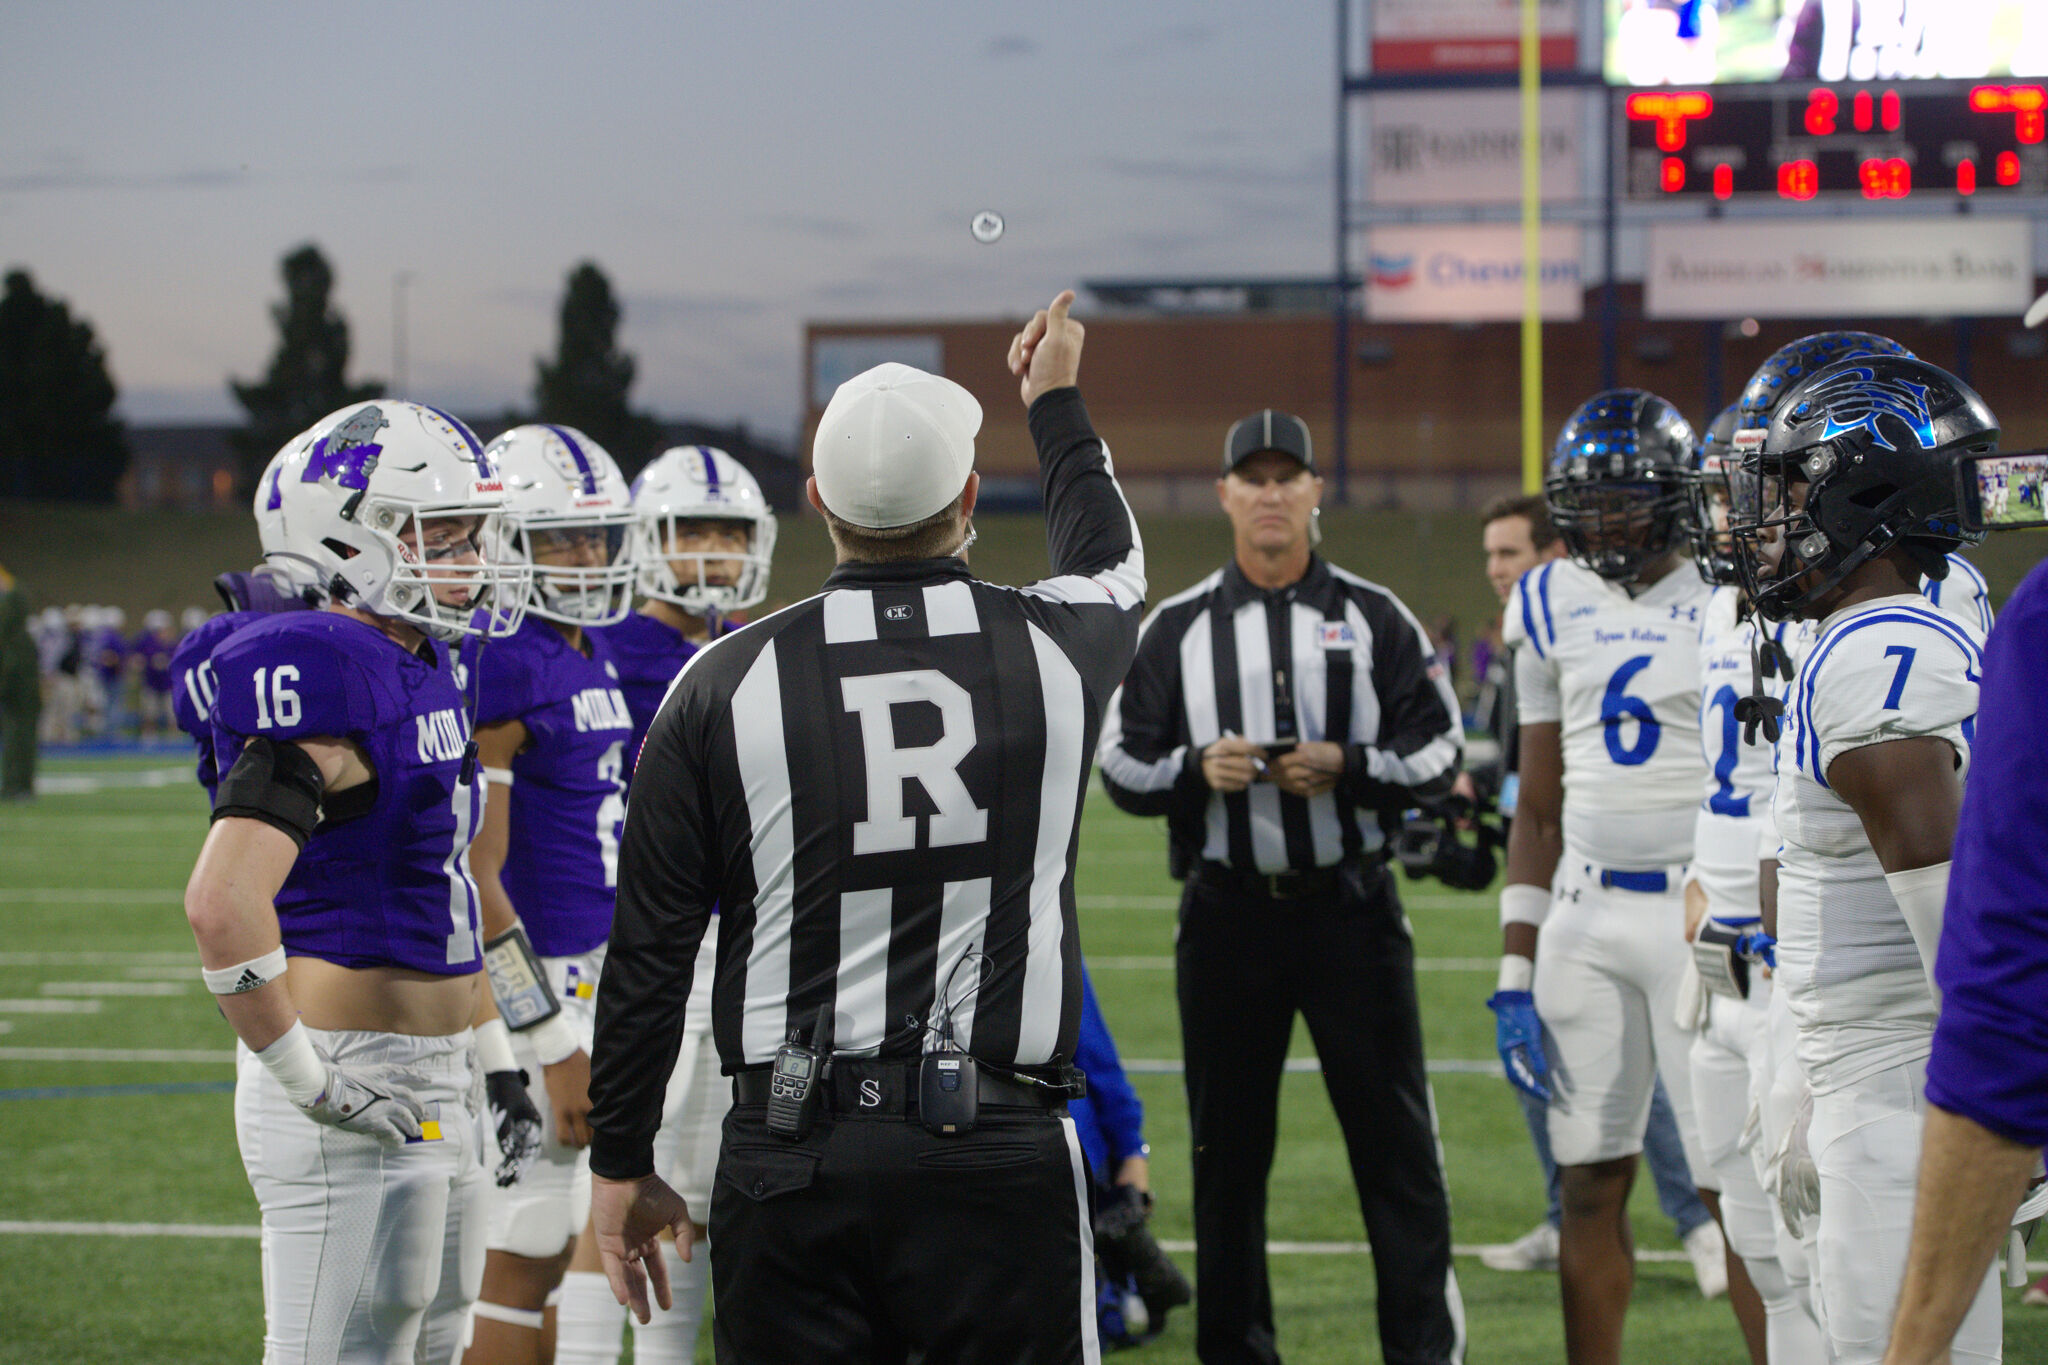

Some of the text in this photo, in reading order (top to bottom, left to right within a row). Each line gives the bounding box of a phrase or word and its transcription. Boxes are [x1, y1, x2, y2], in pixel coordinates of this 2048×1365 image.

[1428, 255, 1580, 286] Chevon
[253, 664, 302, 729] 16
[1600, 654, 1660, 766] 6
[1883, 645, 1917, 710] 7
[840, 669, 988, 856] R
[234, 978, 267, 992] adidas
[860, 1079, 881, 1107] S
